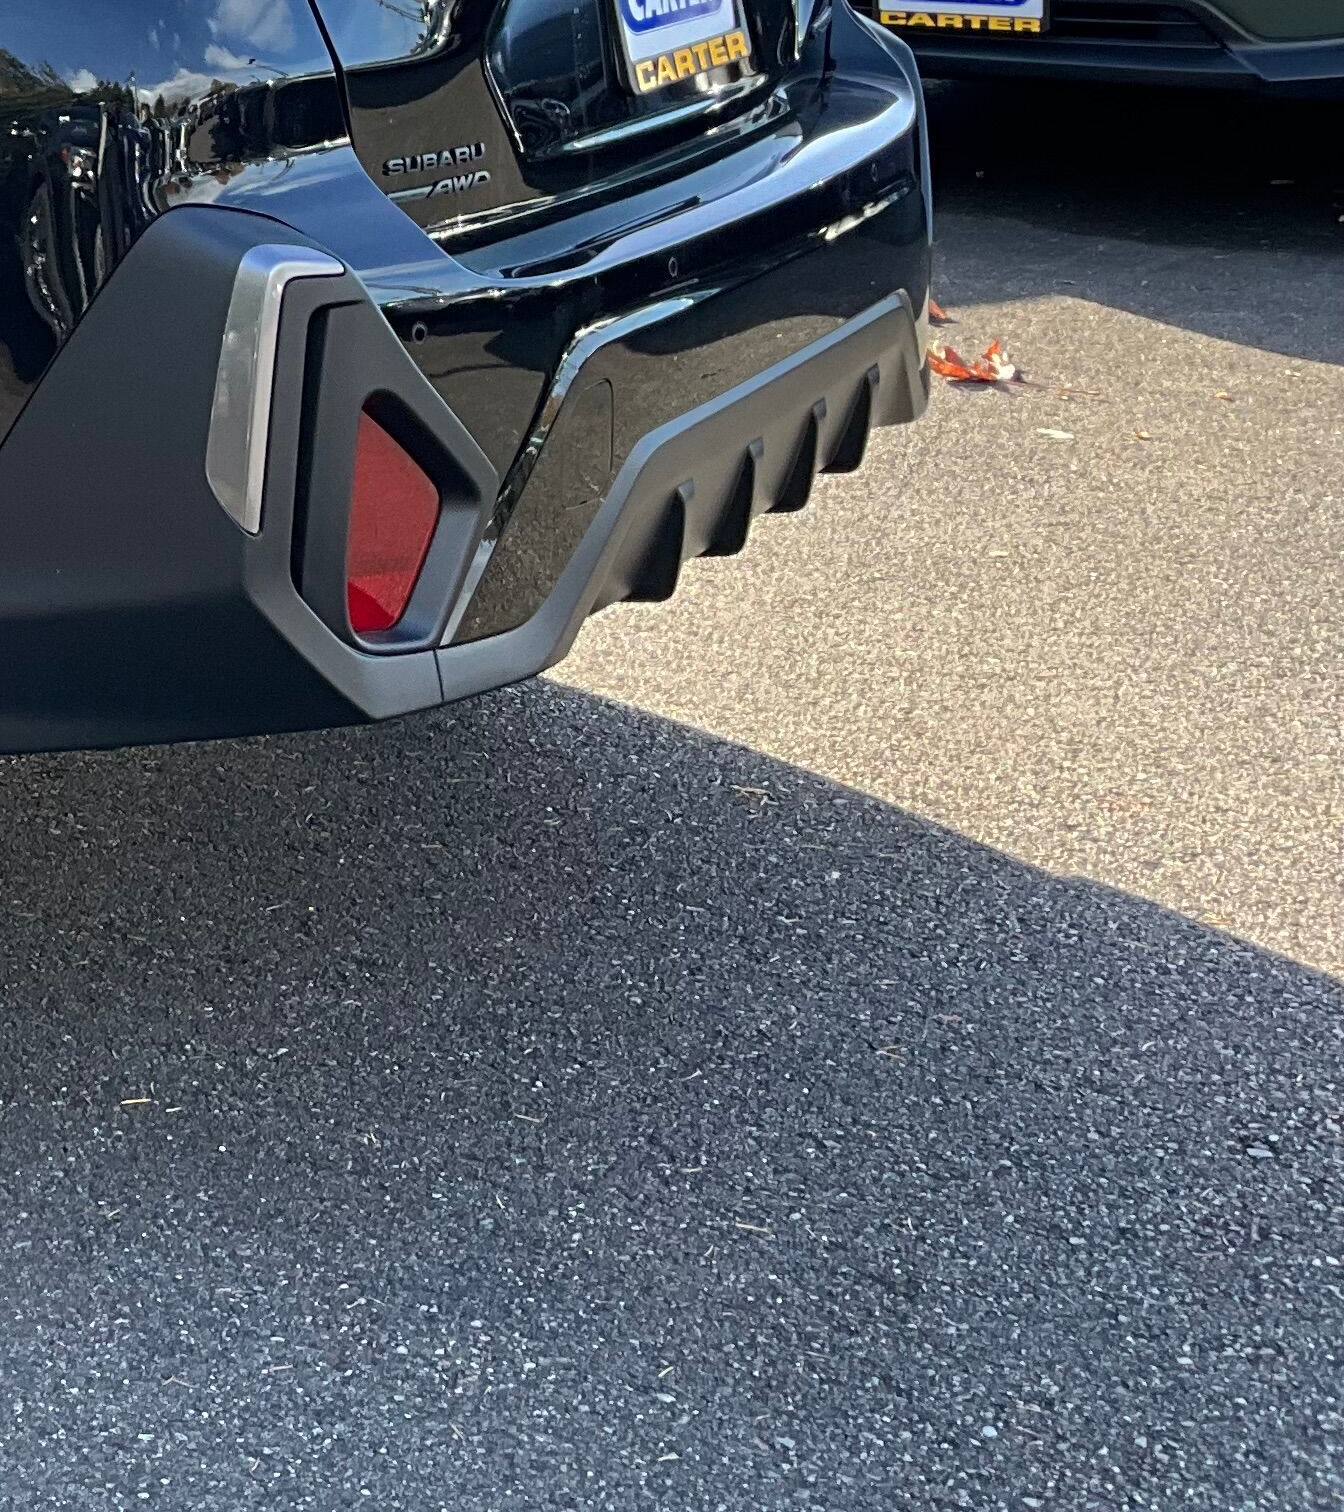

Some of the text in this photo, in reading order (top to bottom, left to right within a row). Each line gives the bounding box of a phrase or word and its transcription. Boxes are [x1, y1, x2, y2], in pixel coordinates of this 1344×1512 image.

[880, 10, 1041, 33] CARTER
[634, 30, 748, 92] CARTER
[382, 141, 486, 176] SUBARU
[427, 170, 491, 197] AWD
